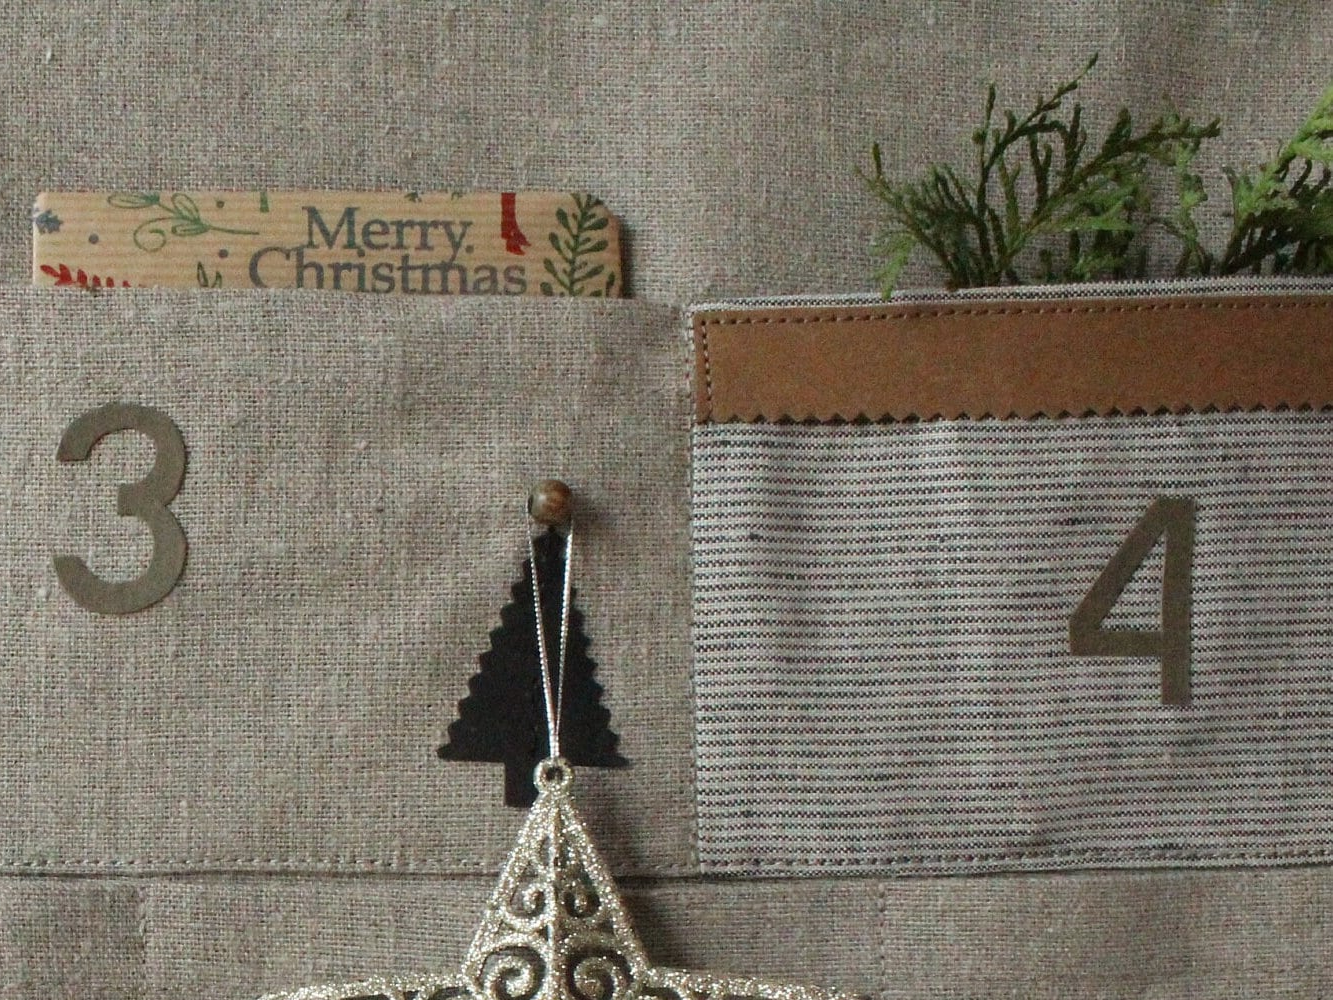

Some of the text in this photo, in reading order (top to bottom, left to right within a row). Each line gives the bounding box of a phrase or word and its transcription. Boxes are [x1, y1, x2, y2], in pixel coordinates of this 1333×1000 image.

[248, 246, 528, 295] Christmas
[55, 402, 187, 612] 3
[1070, 497, 1197, 708] 4
